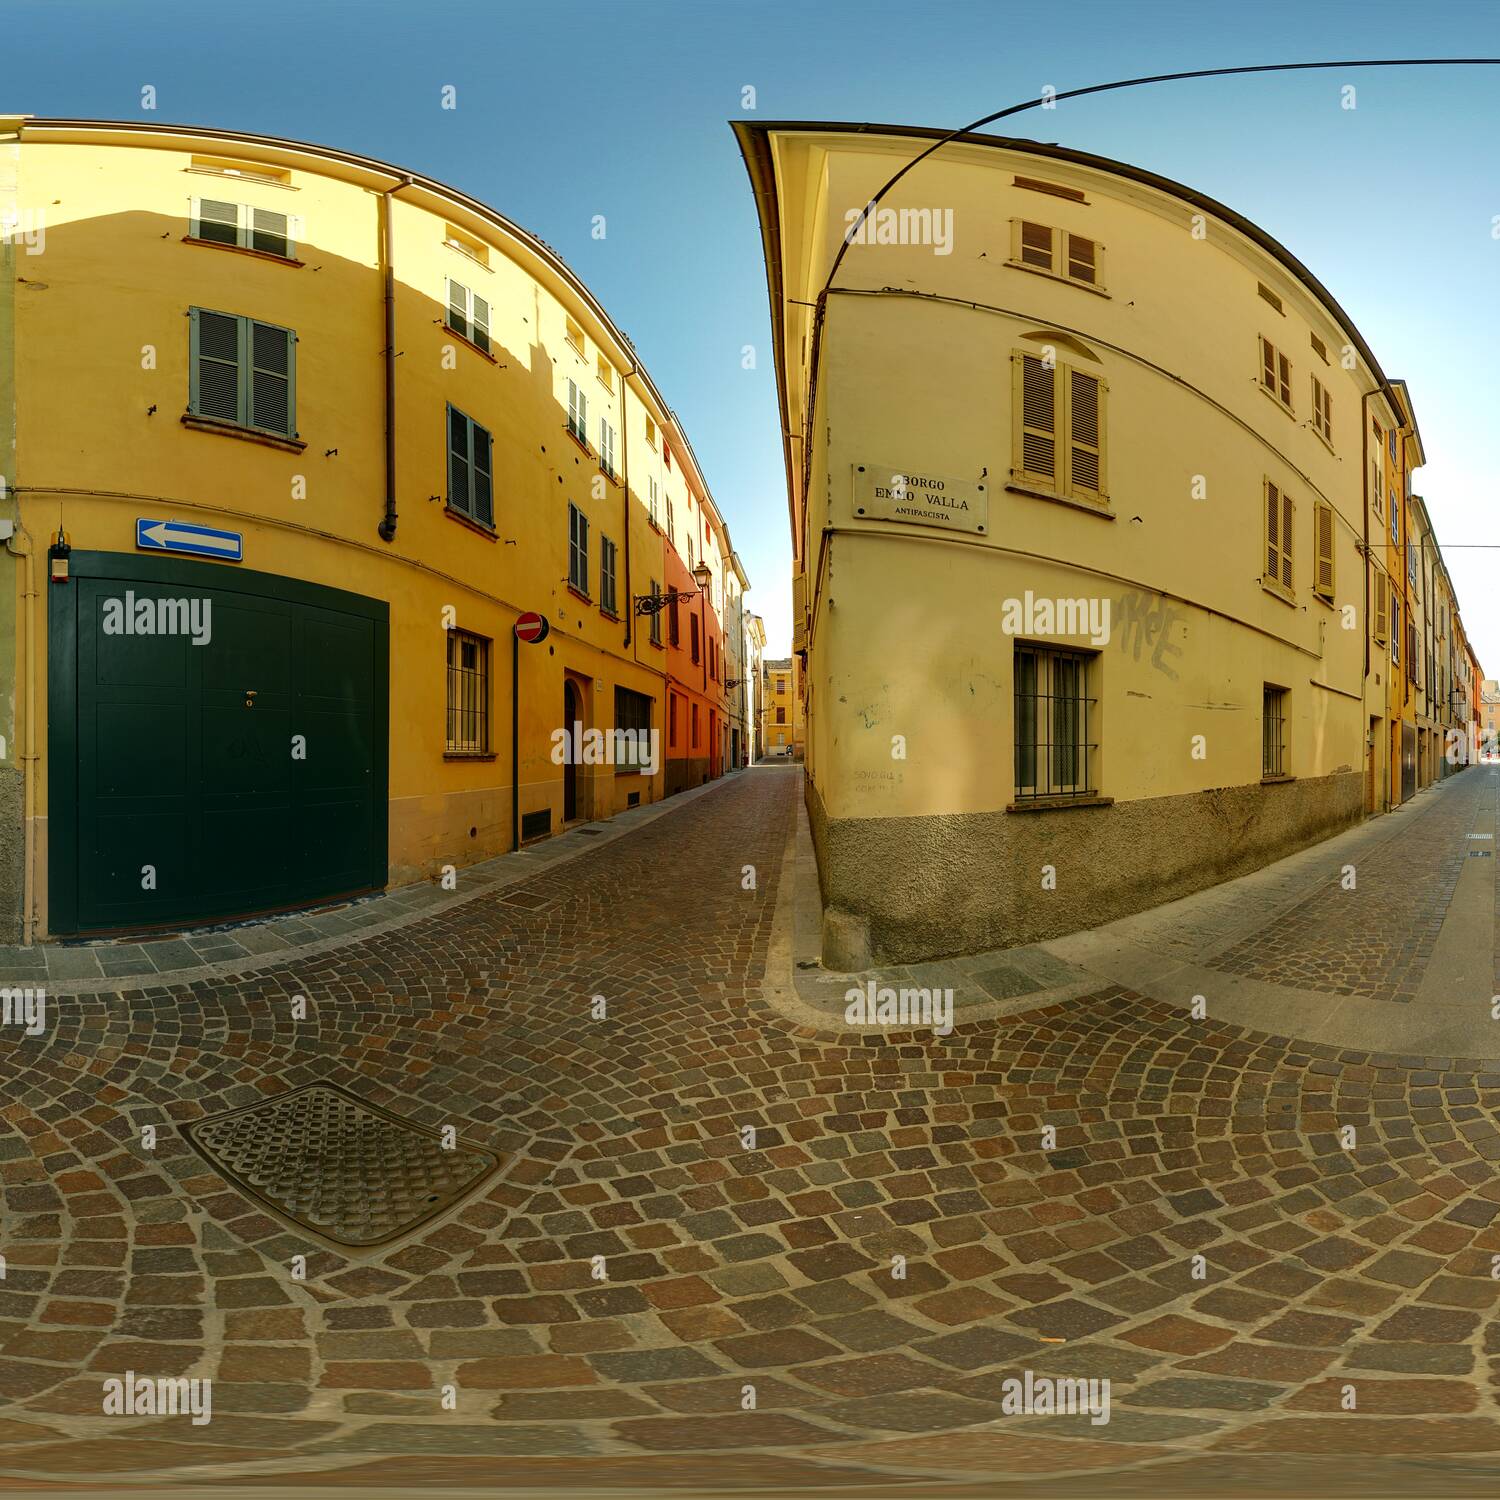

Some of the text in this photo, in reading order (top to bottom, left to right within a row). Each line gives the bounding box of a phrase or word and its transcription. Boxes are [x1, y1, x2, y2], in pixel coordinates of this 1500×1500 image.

[902, 475, 945, 491] BORGO
[925, 494, 969, 510] VALLA
[895, 507, 950, 520] ANTIFASCISTA
